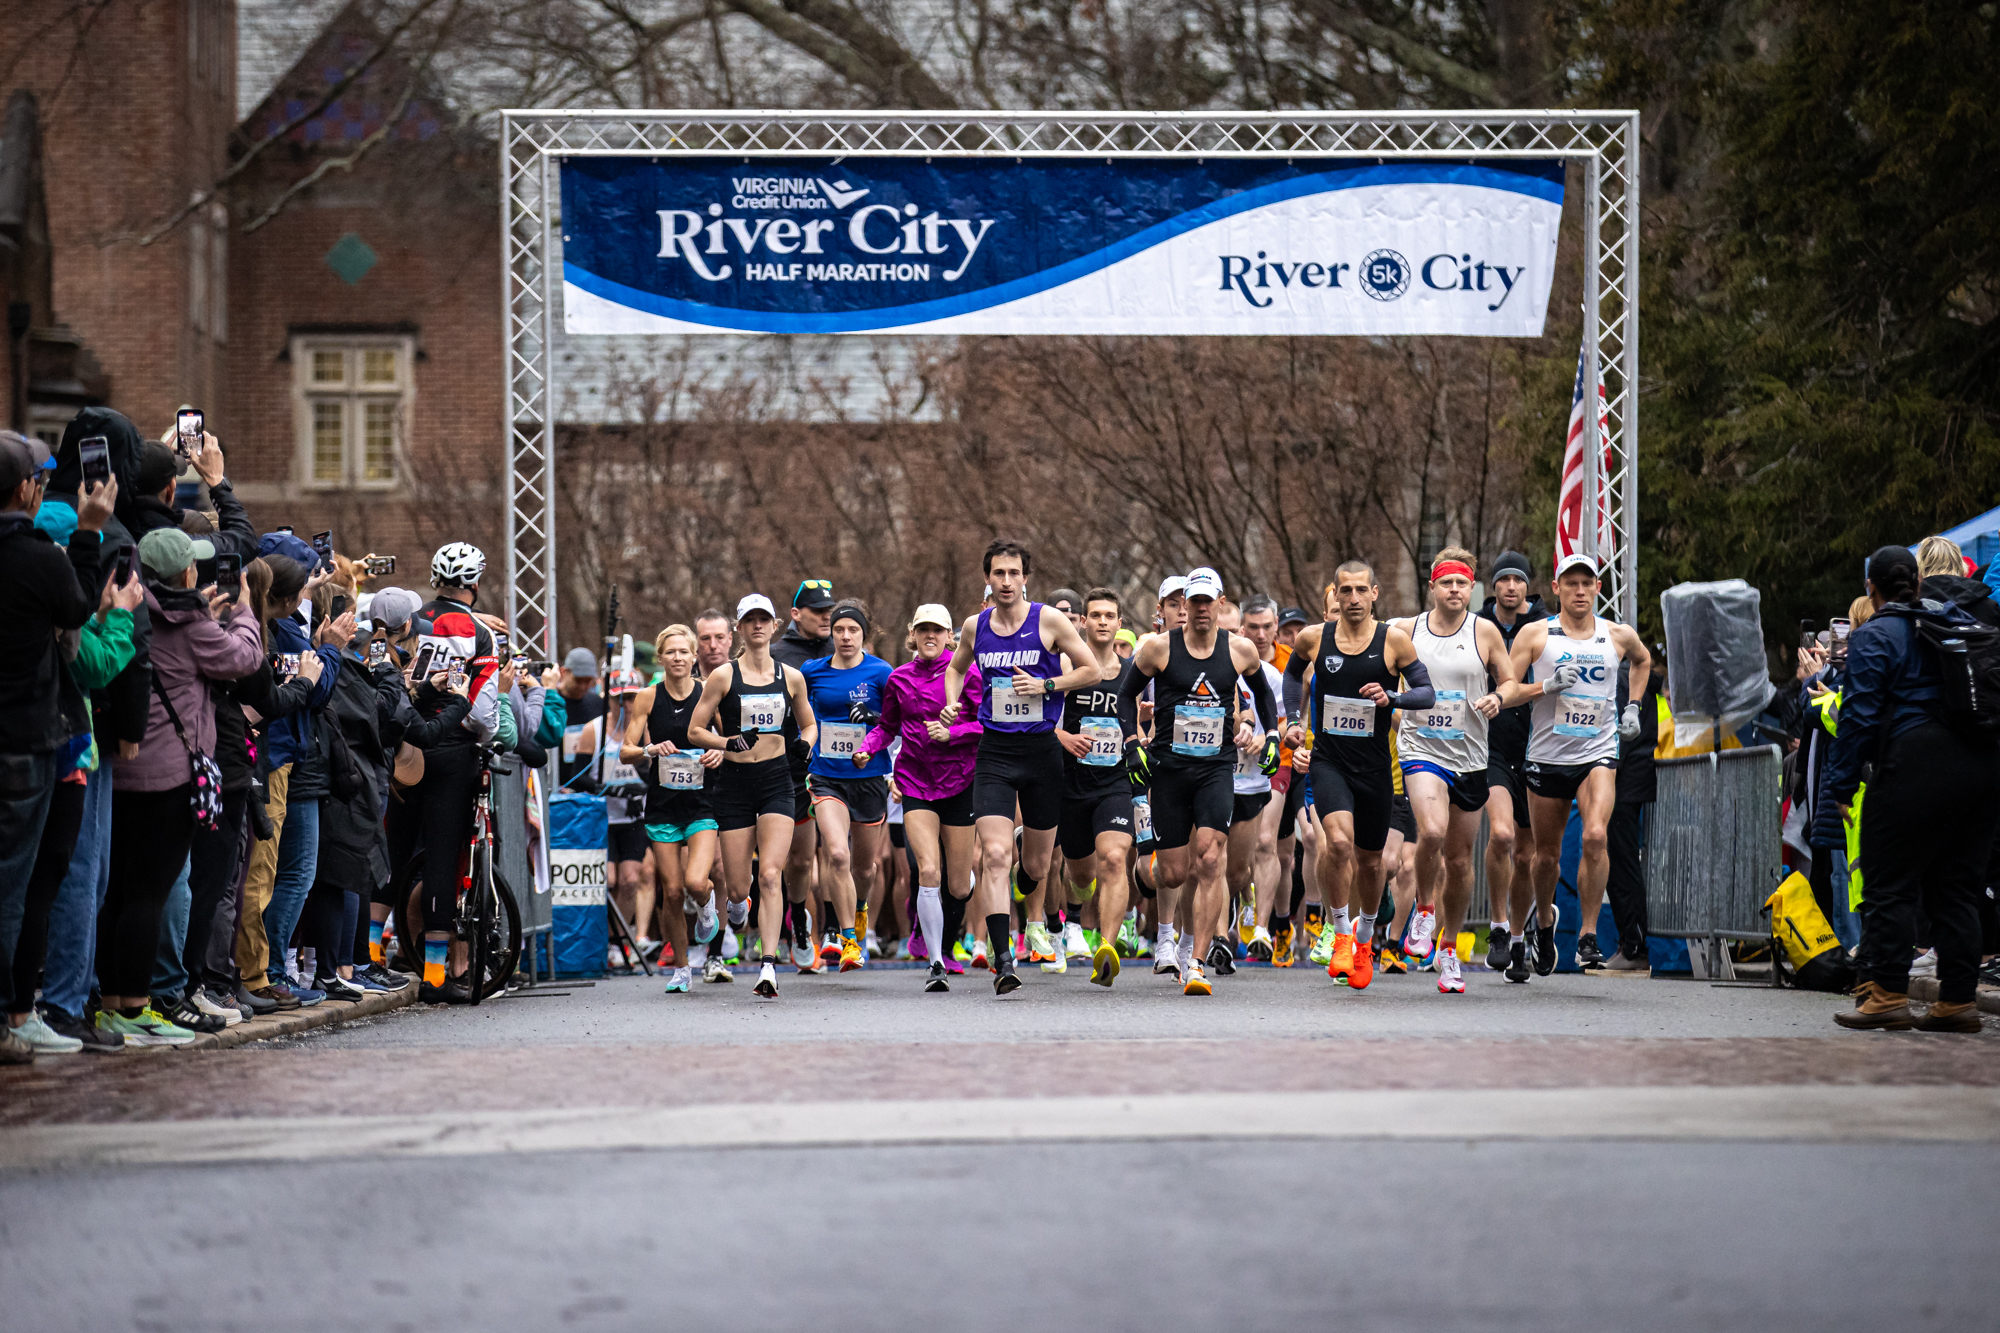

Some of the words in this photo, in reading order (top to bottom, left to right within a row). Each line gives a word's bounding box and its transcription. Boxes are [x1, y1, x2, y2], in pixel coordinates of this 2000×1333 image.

[732, 177, 818, 195] VIRGINIA
[731, 194, 780, 209] Credit
[781, 194, 828, 209] Union
[655, 203, 834, 282] River
[848, 203, 994, 281] City
[745, 263, 803, 281] HALF
[806, 263, 930, 282] MARATHON
[1218, 250, 1350, 308] River
[1421, 253, 1526, 312] City
[979, 650, 1041, 671] PORTLAND
[1004, 703, 1030, 716] 915
[750, 713, 774, 725] 198
[1332, 716, 1366, 730] 1206
[1427, 715, 1453, 727] 892
[1564, 711, 1596, 726] 1622
[1183, 731, 1215, 745] 1752
[831, 740, 854, 753] 439
[670, 771, 693, 784] 753
